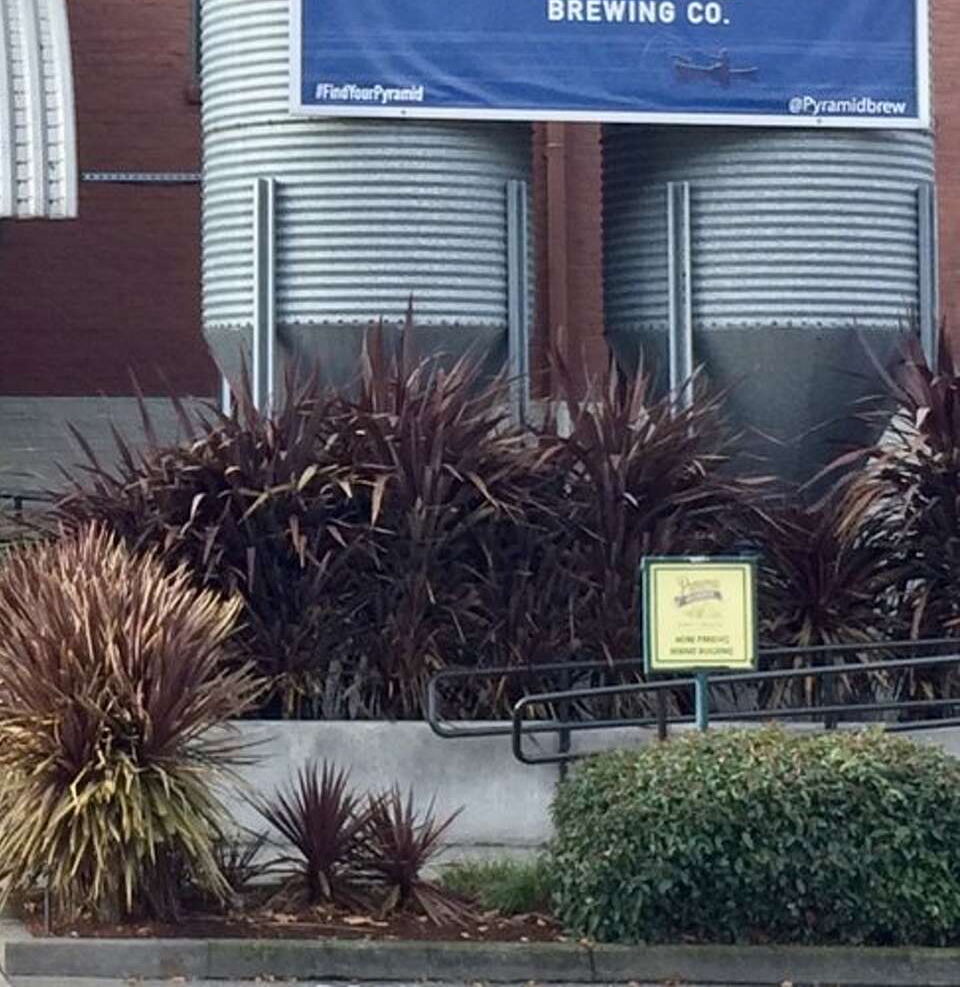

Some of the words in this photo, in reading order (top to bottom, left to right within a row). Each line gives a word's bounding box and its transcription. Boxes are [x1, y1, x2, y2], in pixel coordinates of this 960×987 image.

[687, 2, 731, 25] CO.
[315, 83, 424, 104] #FindYourPyramid
[788, 96, 906, 116] @Pyramidbrew
